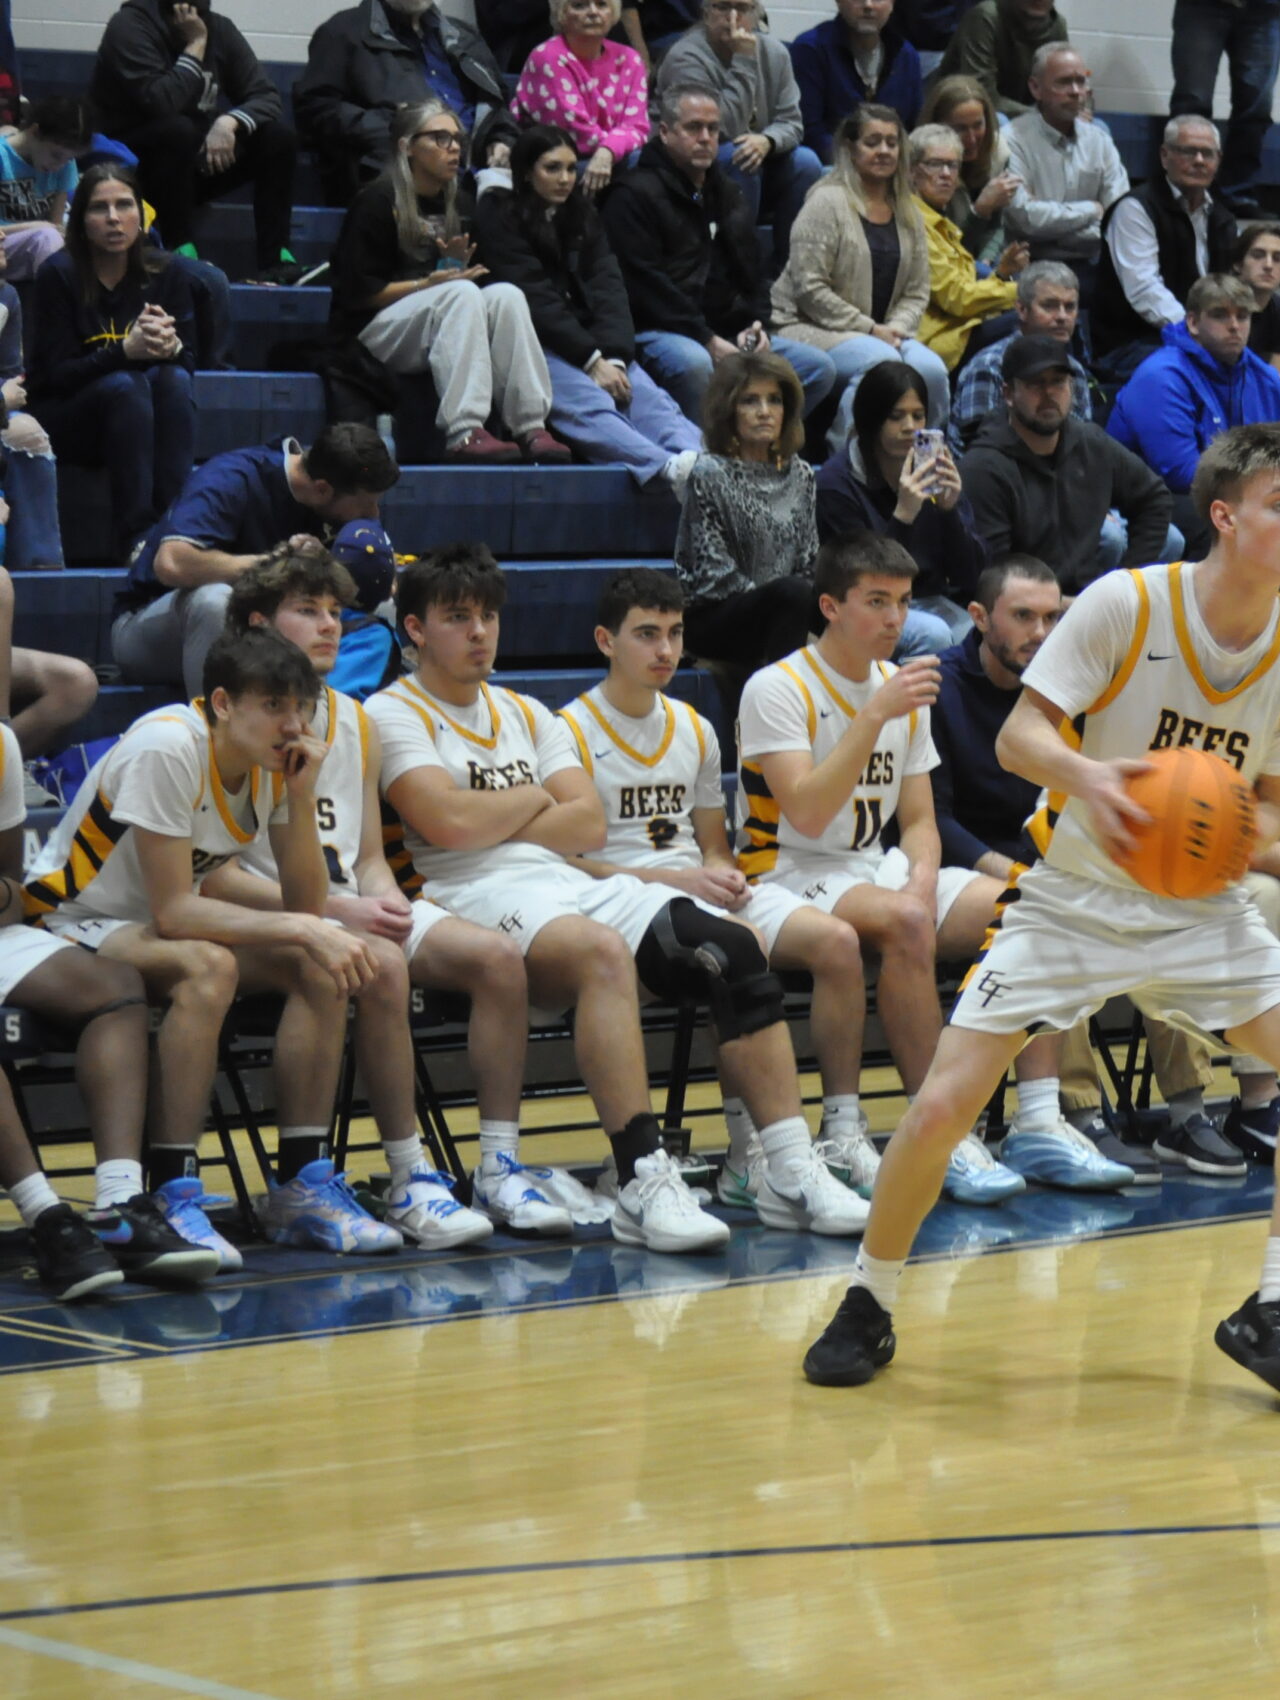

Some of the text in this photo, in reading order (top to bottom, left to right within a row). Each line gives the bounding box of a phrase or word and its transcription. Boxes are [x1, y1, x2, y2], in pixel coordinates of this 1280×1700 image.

[1149, 708, 1250, 771] BEES
[619, 784, 686, 819] BEES
[849, 797, 882, 851] 11
